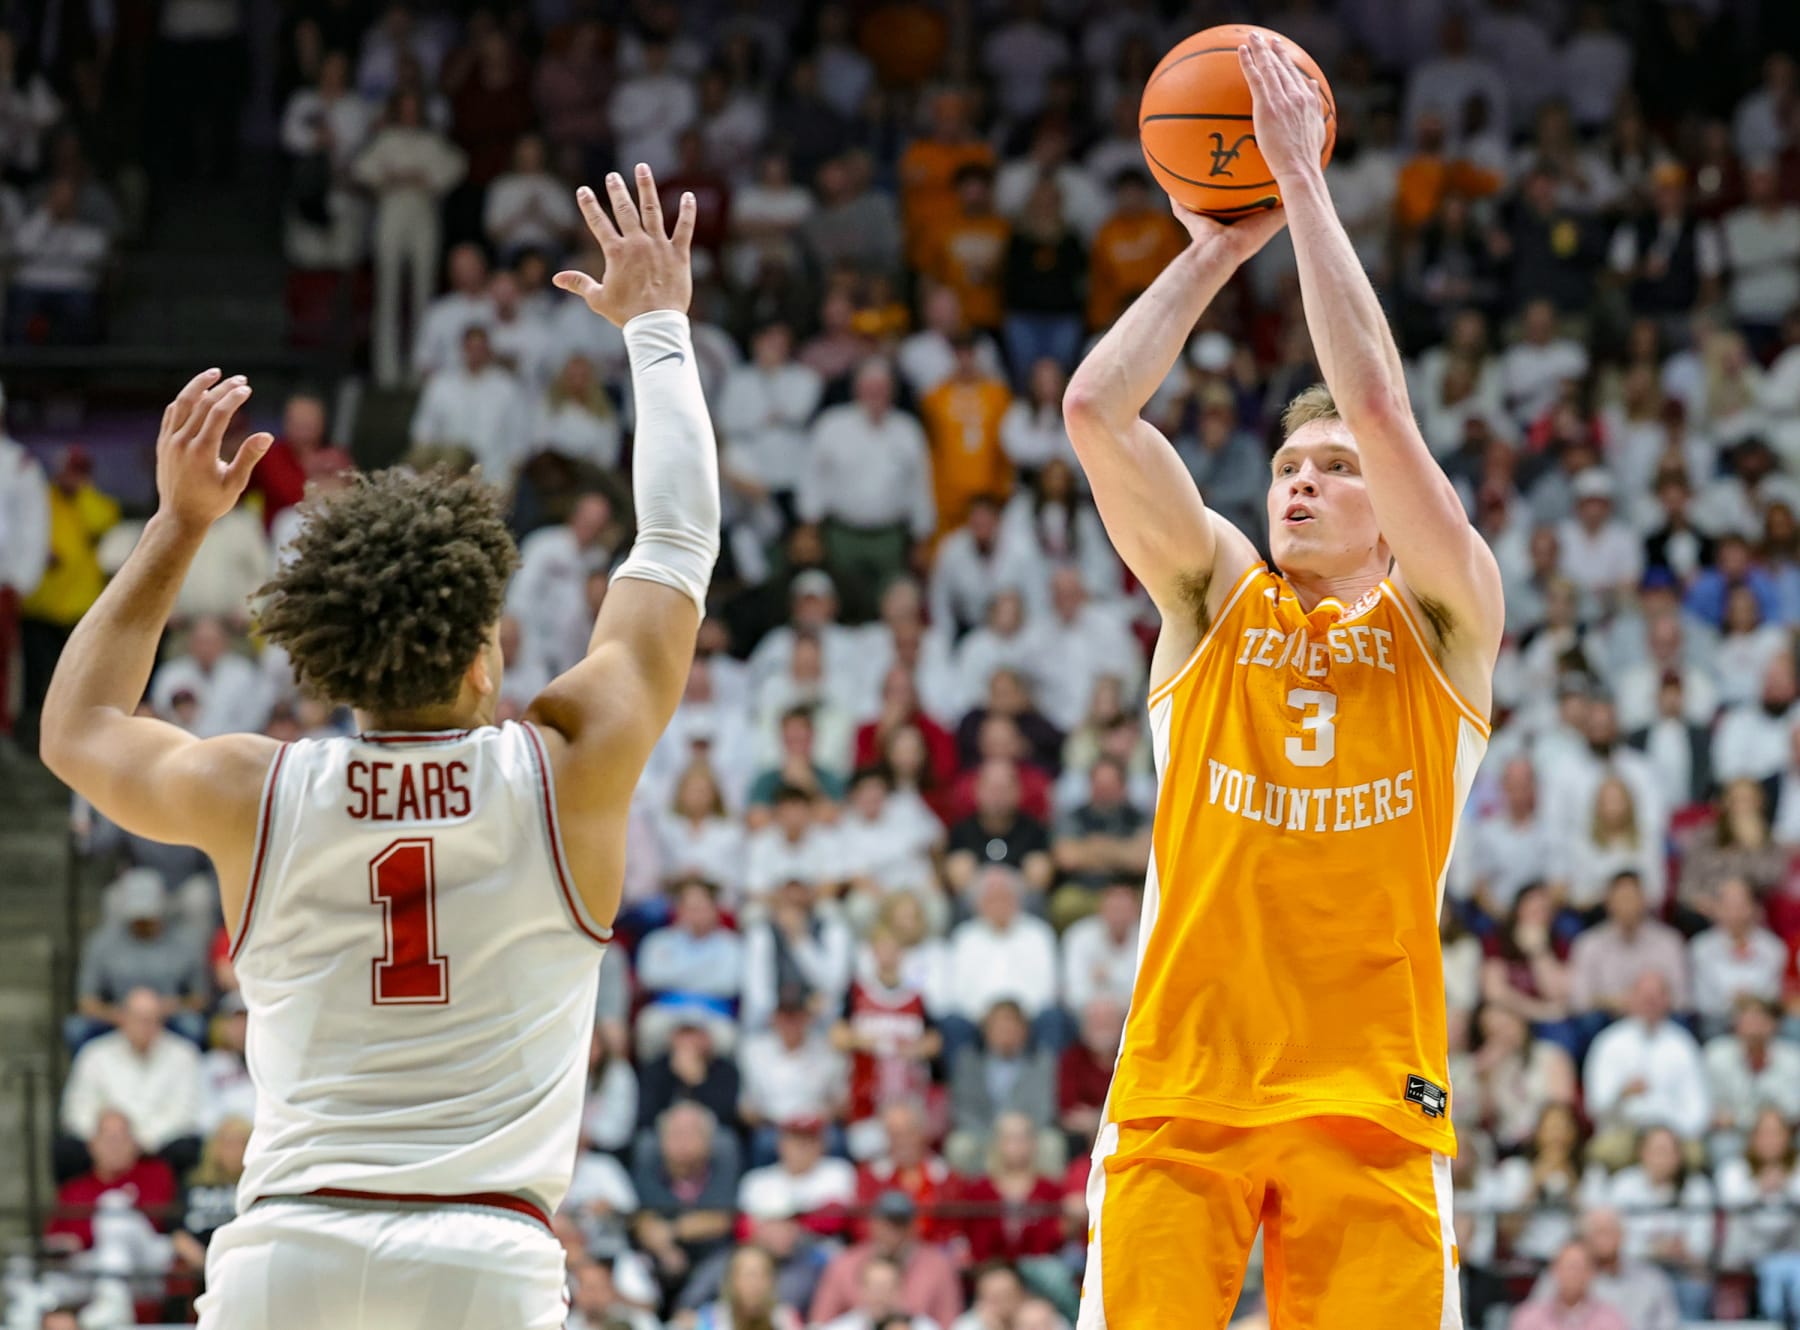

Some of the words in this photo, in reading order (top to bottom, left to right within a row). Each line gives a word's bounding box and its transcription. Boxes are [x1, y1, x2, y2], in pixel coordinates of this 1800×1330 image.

[1237, 626, 1396, 677] TEESEE
[1284, 687, 1337, 767] 3
[346, 760, 472, 821] SEARS
[1208, 758, 1414, 832] VOLUNTEERS
[369, 837, 449, 1006] 1
